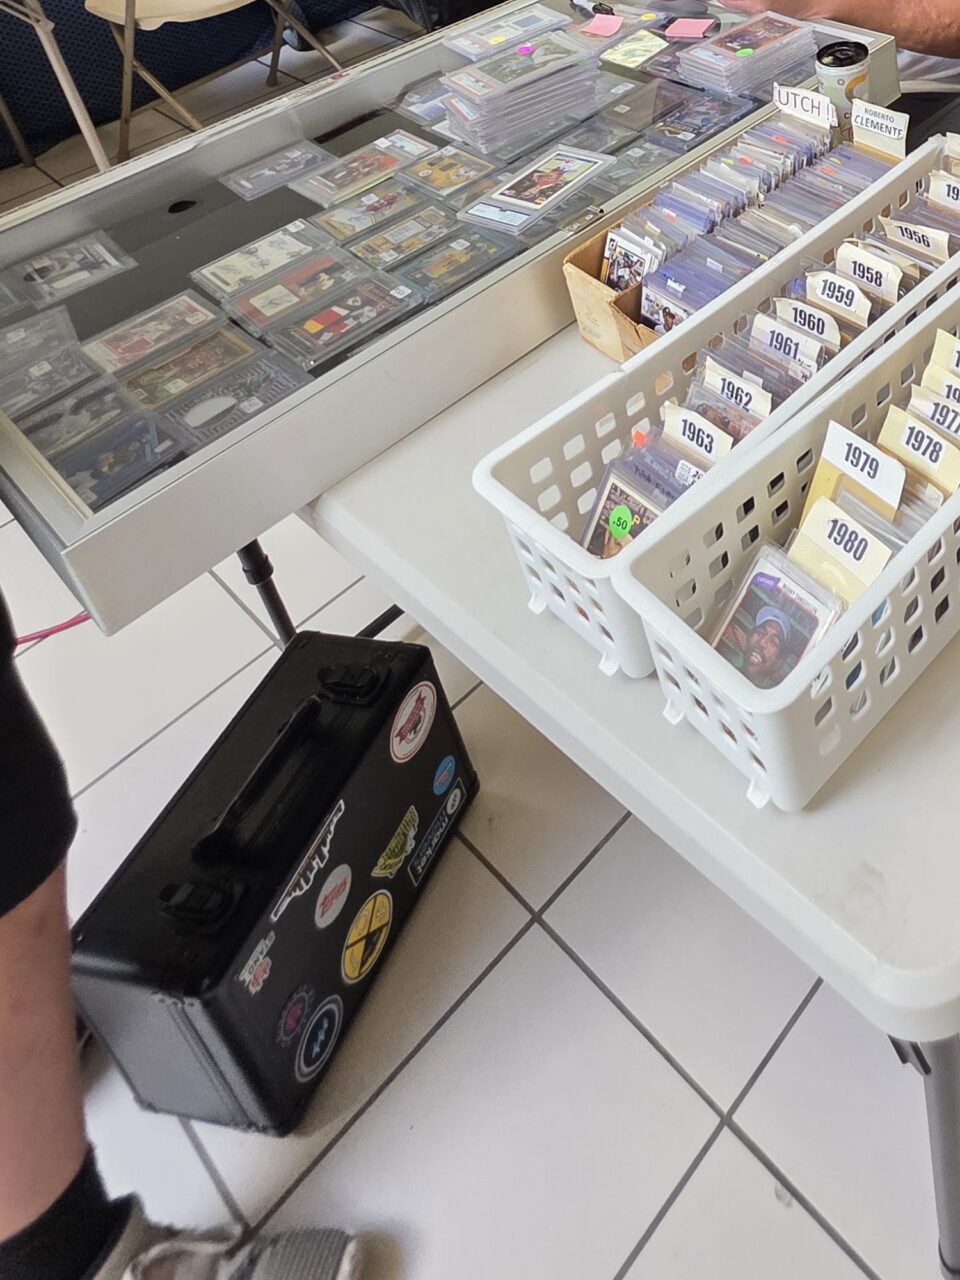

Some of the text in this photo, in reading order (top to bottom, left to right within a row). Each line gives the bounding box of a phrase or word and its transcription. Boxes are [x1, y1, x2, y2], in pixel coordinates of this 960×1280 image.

[774, 86, 821, 117] UTCH
[864, 108, 895, 123] ROBERTO
[854, 114, 904, 138] CLEMENTE
[895, 222, 932, 249] 1956
[850, 259, 885, 288] 1958
[820, 278, 855, 307] 1959
[791, 306, 825, 336] 1960
[768, 329, 800, 360] 1961
[720, 377, 753, 412] 1962
[681, 418, 714, 454] 1963
[904, 425, 943, 464] 1978
[843, 441, 880, 480] 1979
[612, 517, 628, 531] .50
[826, 518, 869, 562] 1980
[416, 816, 449, 874] market
